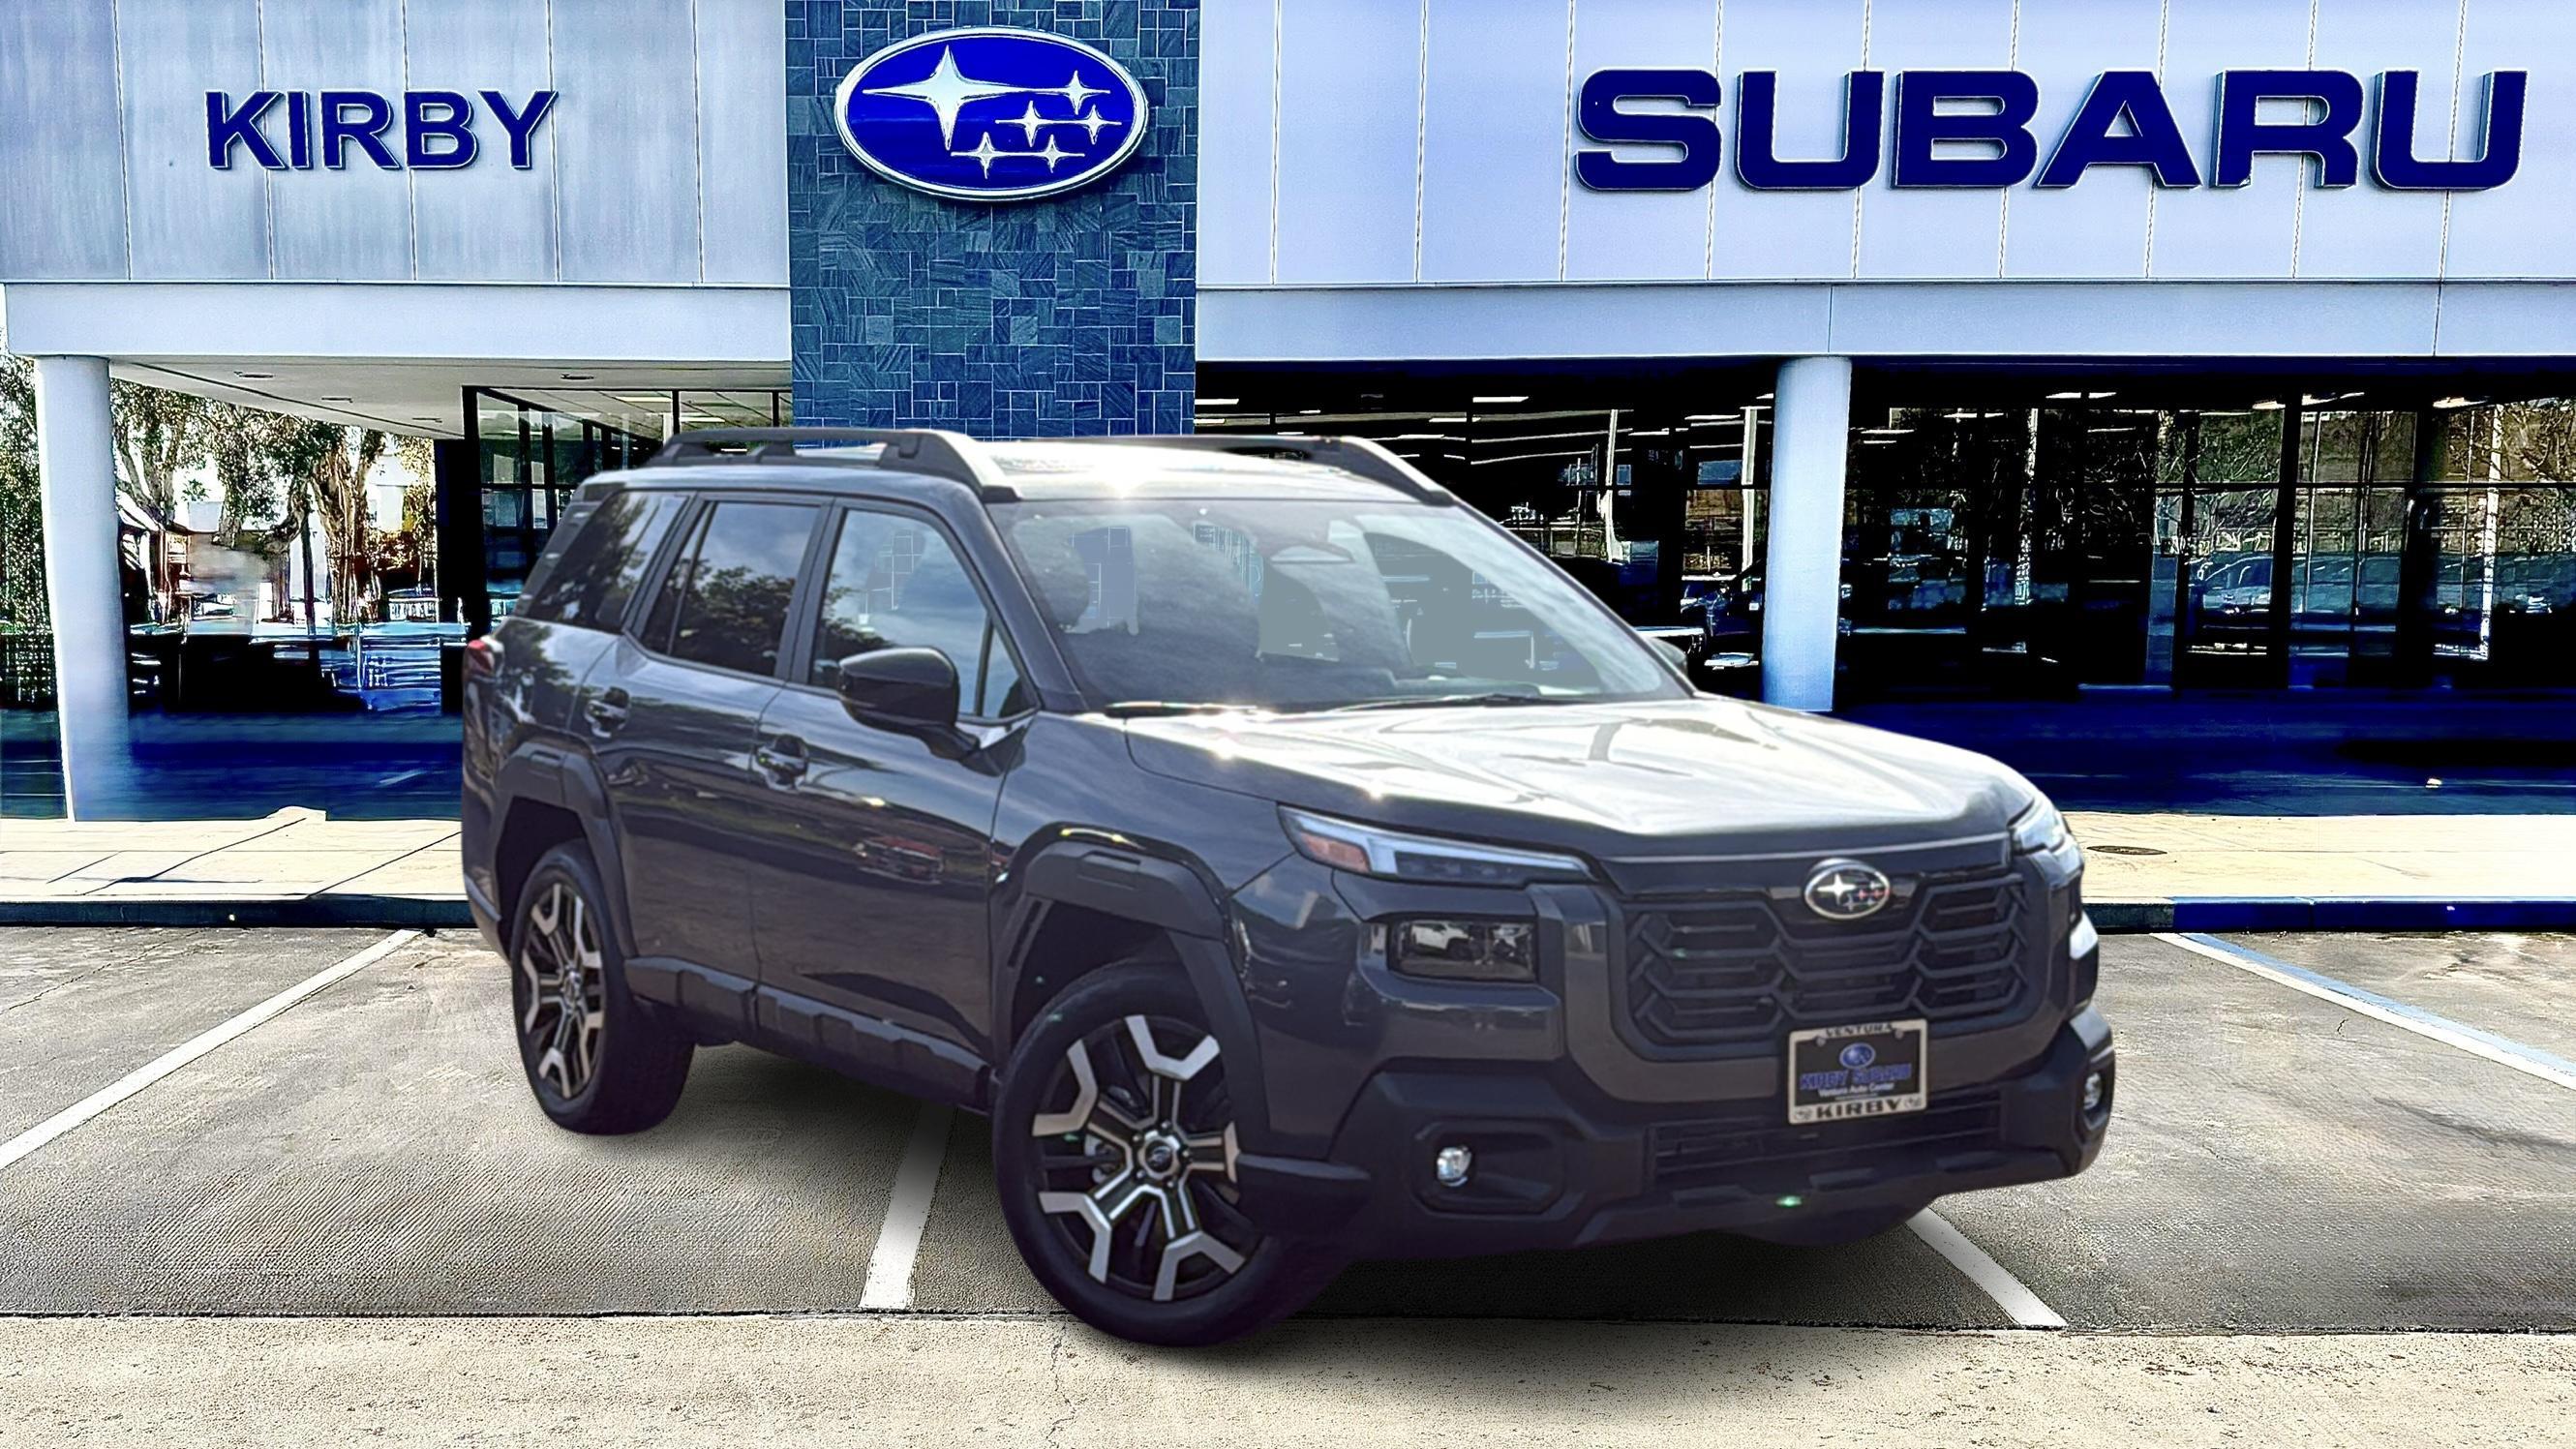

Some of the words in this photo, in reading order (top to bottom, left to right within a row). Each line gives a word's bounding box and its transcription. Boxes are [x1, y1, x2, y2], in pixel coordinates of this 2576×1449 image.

[205, 90, 559, 169] KIRBY
[1575, 69, 2528, 192] SUBARU
[1826, 1023, 1893, 1036] VENTURA
[1800, 1071, 1848, 1090] KIRBY
[1816, 1100, 1900, 1118] KIRBY
